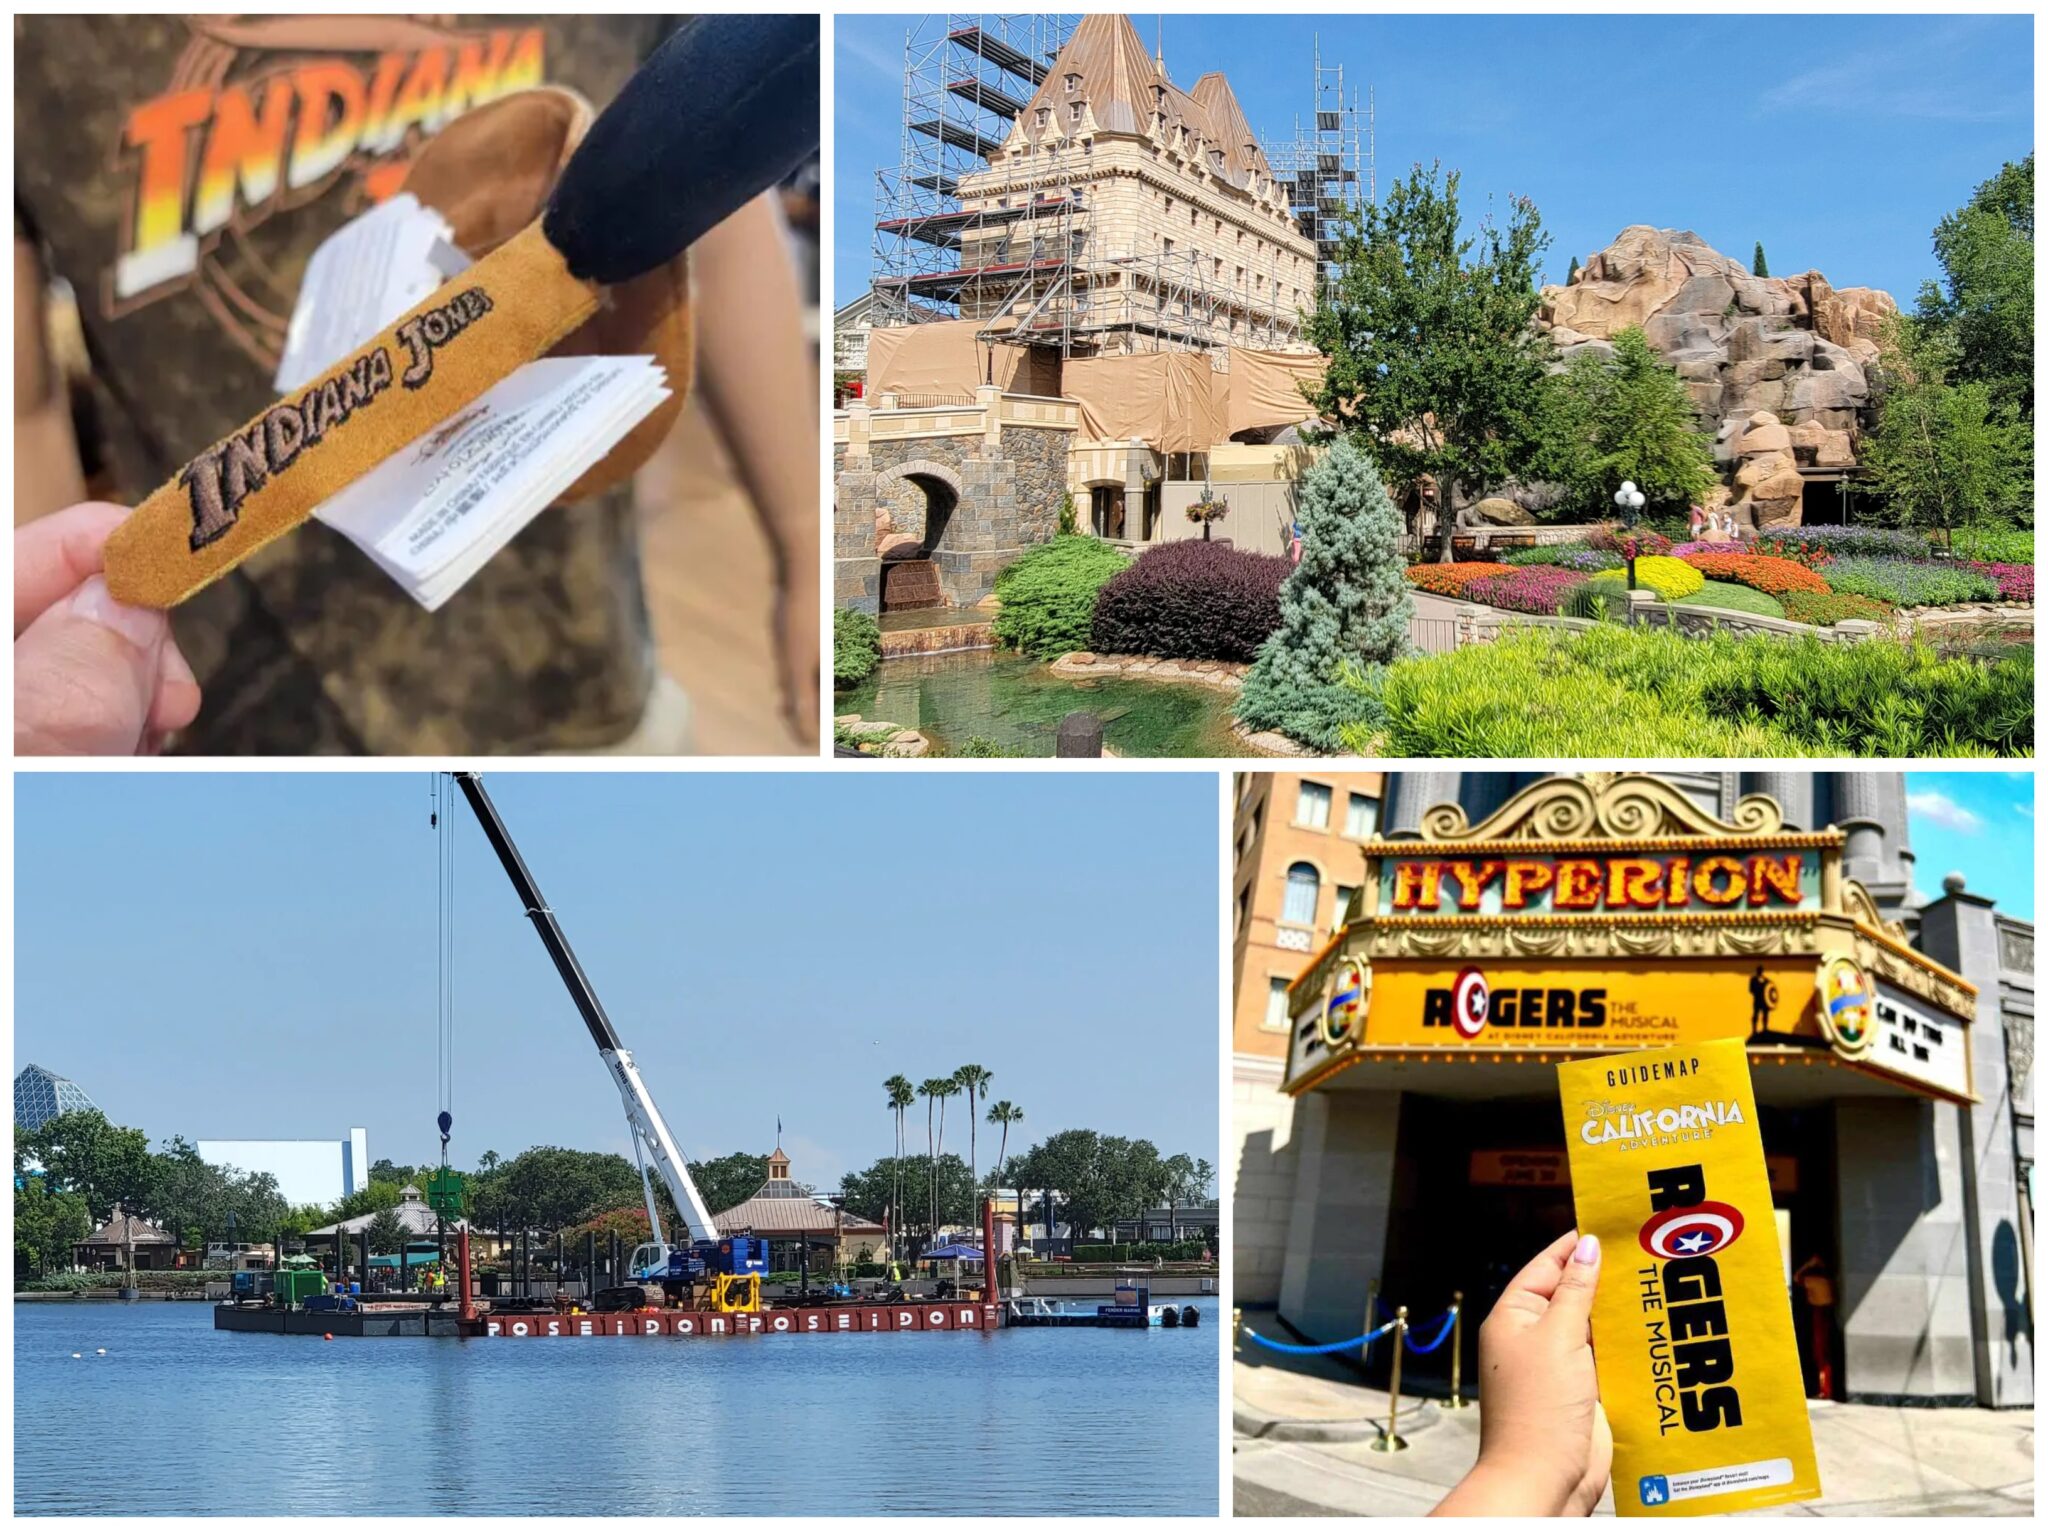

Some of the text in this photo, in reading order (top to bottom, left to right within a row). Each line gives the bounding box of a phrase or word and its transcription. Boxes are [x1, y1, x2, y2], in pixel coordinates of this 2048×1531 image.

[113, 26, 547, 300] INDIANA
[178, 346, 394, 553] INDIANA
[395, 286, 495, 391] JONES
[1392, 854, 1805, 909] HYPERION
[1610, 1002, 1638, 1014] THE
[1610, 1016, 1679, 1029] MUSICAL
[614, 1060, 629, 1085] Sims
[1606, 1057, 1700, 1088] GUIDEMAP
[1580, 1099, 1745, 1146] CALIFORNIA
[1619, 1130, 1712, 1152] ADVENTURE
[1638, 1263, 1680, 1436] THE MUSICAL
